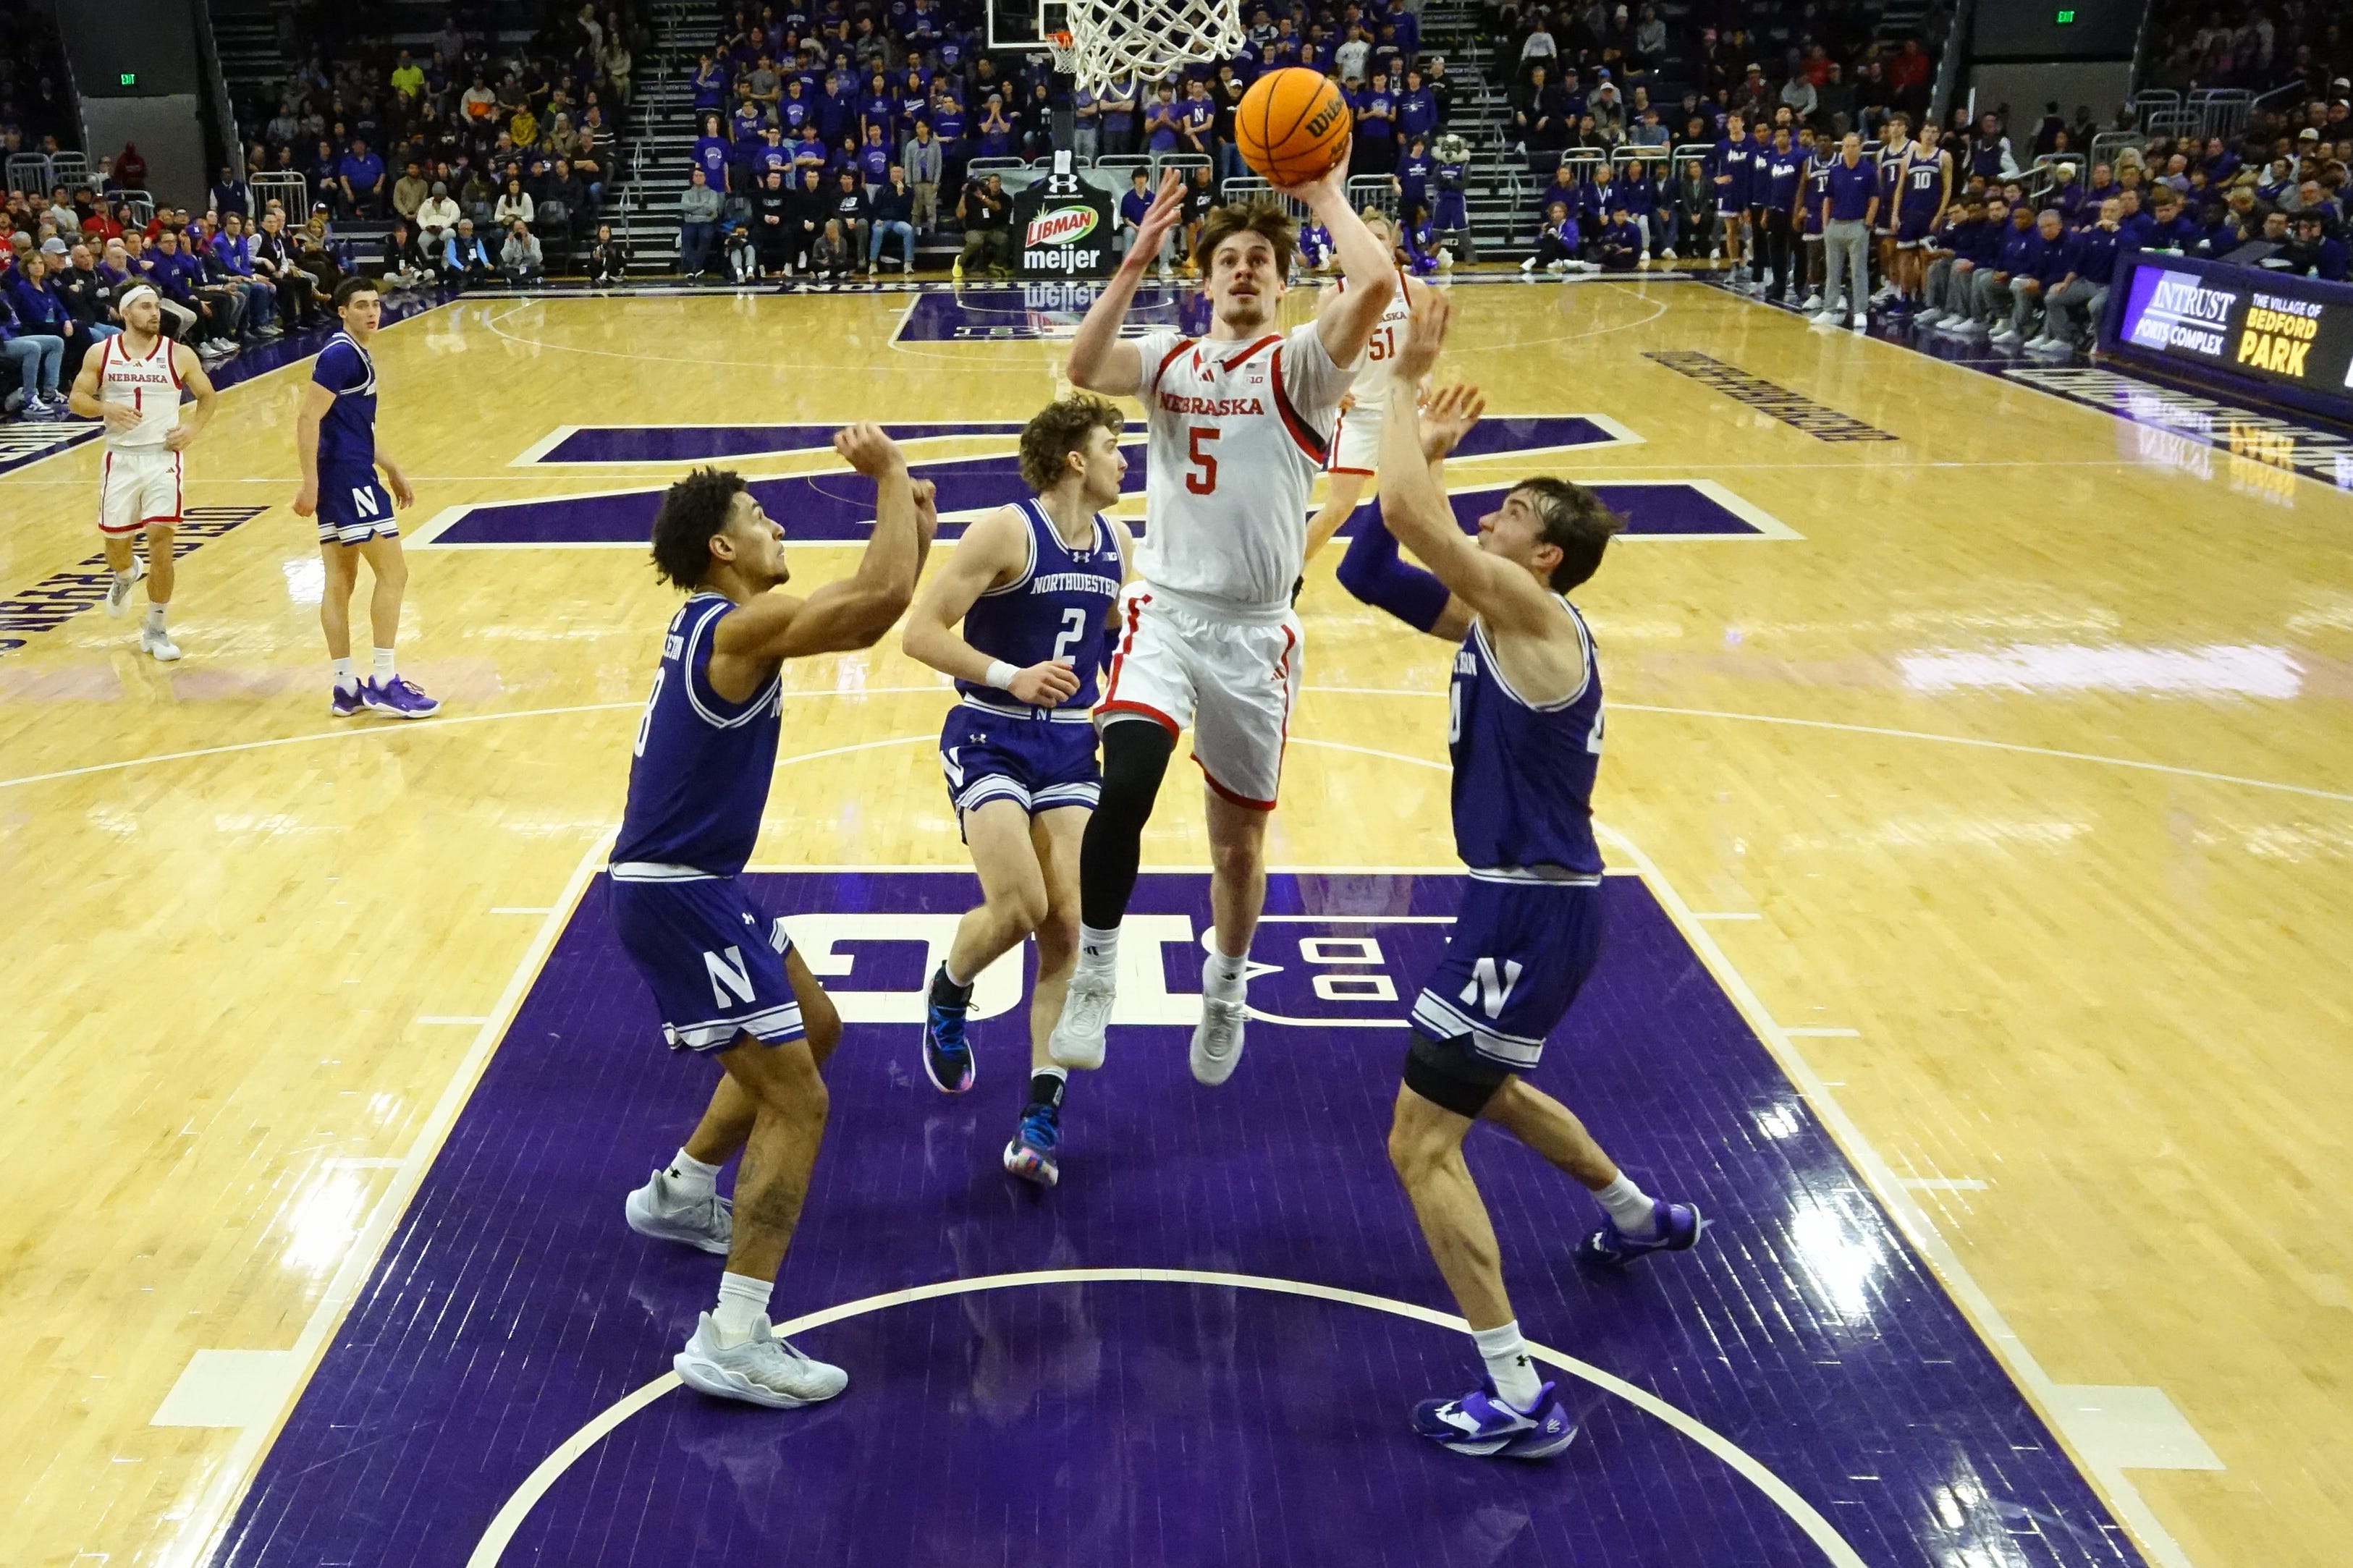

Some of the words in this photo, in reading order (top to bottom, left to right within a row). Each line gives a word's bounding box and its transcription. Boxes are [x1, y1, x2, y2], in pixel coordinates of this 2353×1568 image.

[121, 74, 135, 85] EXIT
[1195, 108, 1204, 122] N
[1914, 171, 1931, 190] 10
[1025, 211, 1092, 247] LIBMAN
[1024, 243, 1100, 274] meijer
[2252, 292, 2270, 308] THE
[2269, 295, 2307, 315] VILLAGE
[2307, 304, 2323, 318] OF
[2246, 308, 2318, 340] BEDFORD
[1369, 326, 1395, 361] 51
[2171, 326, 2225, 356] COMPLEX
[2237, 331, 2312, 378] PARK
[108, 373, 168, 383] NEBRASKA
[133, 386, 141, 412] 1
[1159, 391, 1264, 417] NEBRASKA
[1186, 426, 1221, 495] 5
[352, 486, 379, 518] N
[1052, 608, 1086, 666] 2
[1036, 708, 1047, 721] N
[703, 945, 757, 1010] N
[1459, 957, 1523, 1020] N
